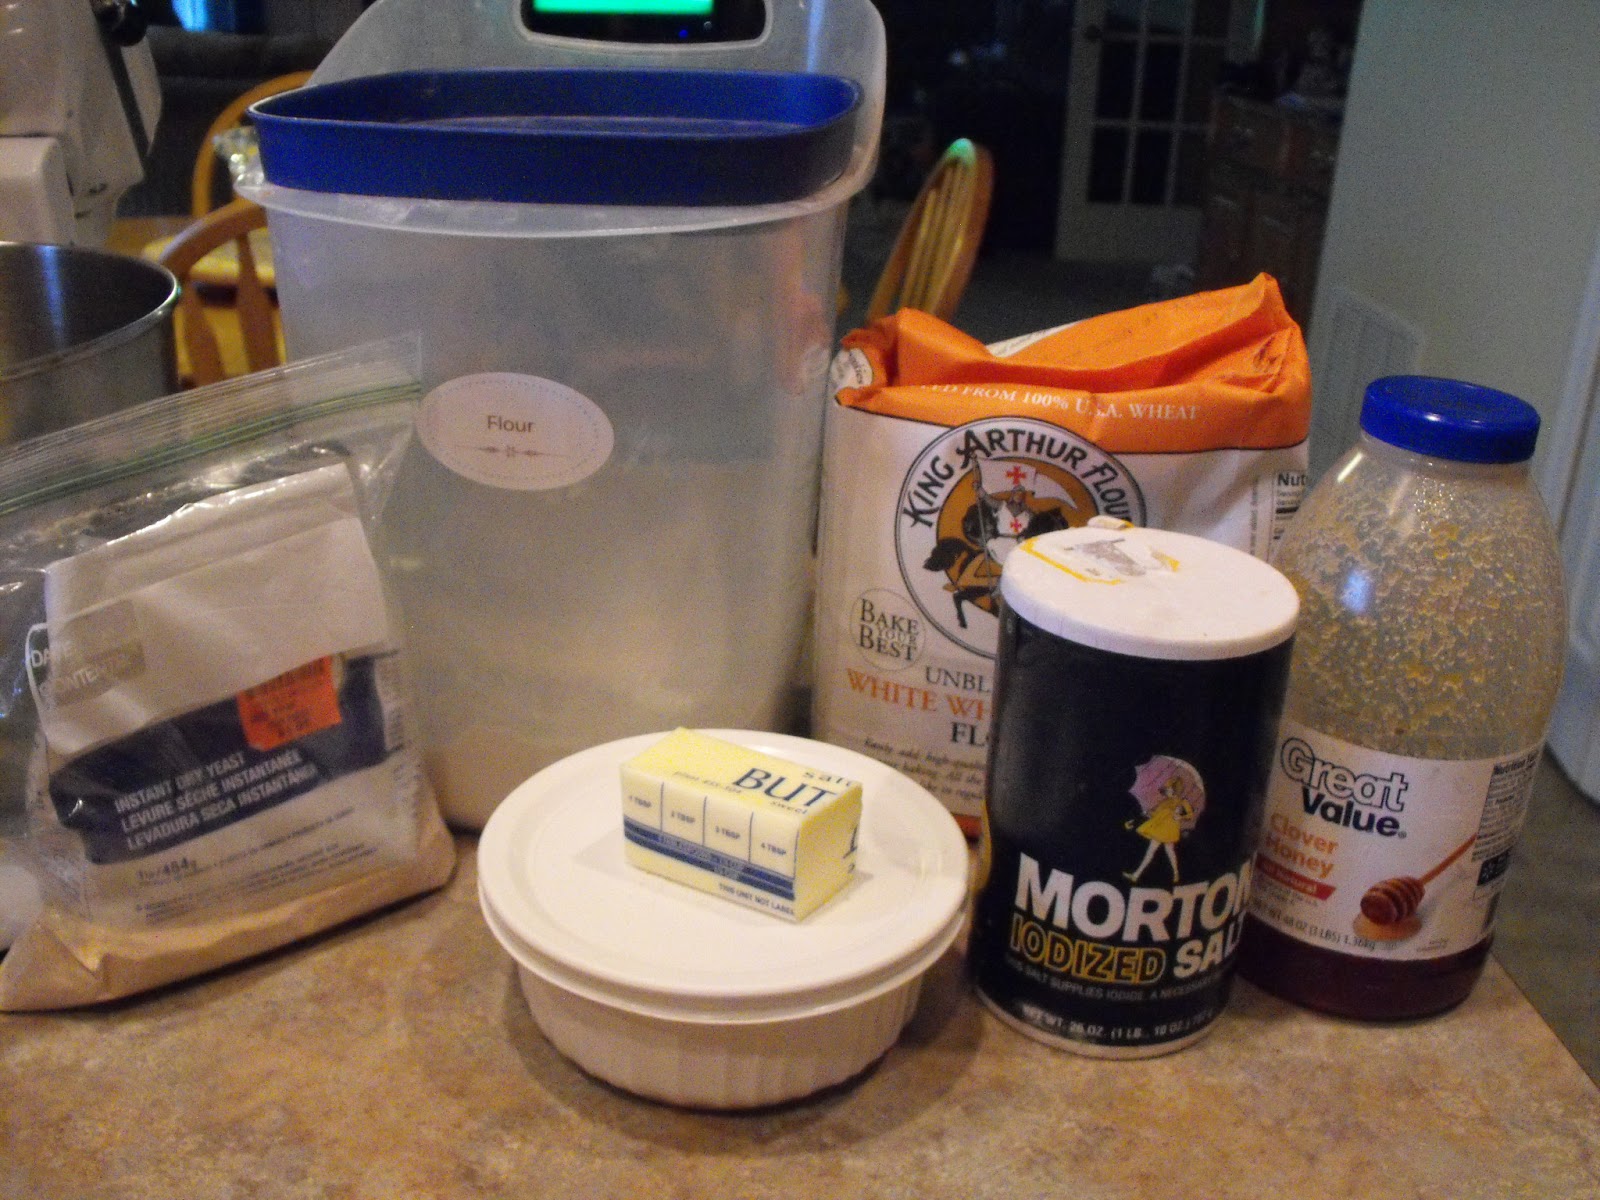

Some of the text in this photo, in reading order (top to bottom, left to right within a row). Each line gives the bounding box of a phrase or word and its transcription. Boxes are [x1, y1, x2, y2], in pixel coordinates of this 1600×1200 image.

[487, 414, 535, 433] Flour
[962, 387, 1018, 402] FROM
[1023, 391, 1069, 410] 100%
[1128, 402, 1200, 421] WHEAT
[903, 455, 954, 529] KING
[955, 429, 1088, 471] ARTHUR
[860, 598, 919, 636] BAKE
[858, 623, 917, 661] BEST
[844, 667, 938, 712] WHITE
[732, 767, 838, 808] BUT
[1280, 737, 1409, 812] Great
[1269, 812, 1338, 855] Clover
[1302, 785, 1401, 840] Value
[1008, 912, 1168, 986] IODIZED
